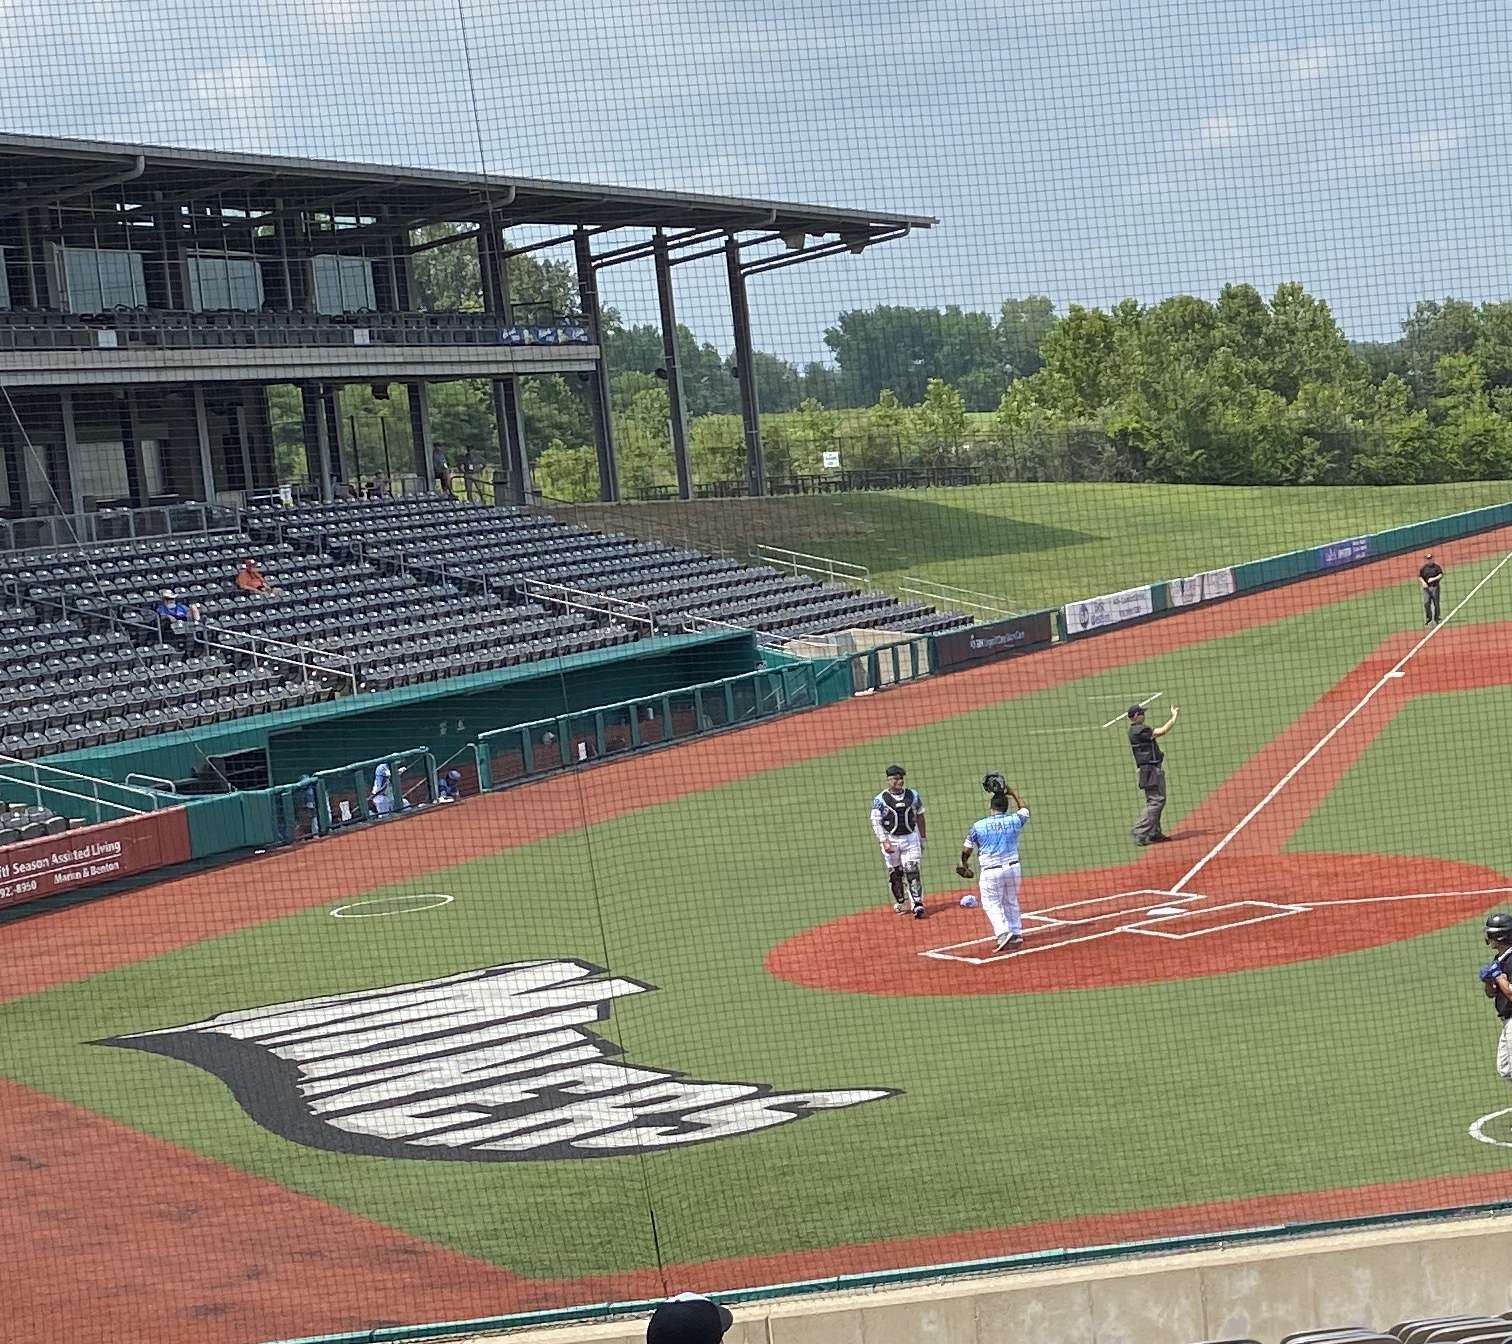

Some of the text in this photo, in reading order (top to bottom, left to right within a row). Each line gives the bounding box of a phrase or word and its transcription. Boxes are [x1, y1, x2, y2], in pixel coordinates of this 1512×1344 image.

[13, 859, 49, 875] Season
[51, 846, 91, 865] Assisted
[91, 841, 121, 857] Living
[90, 861, 119, 877] Benton
